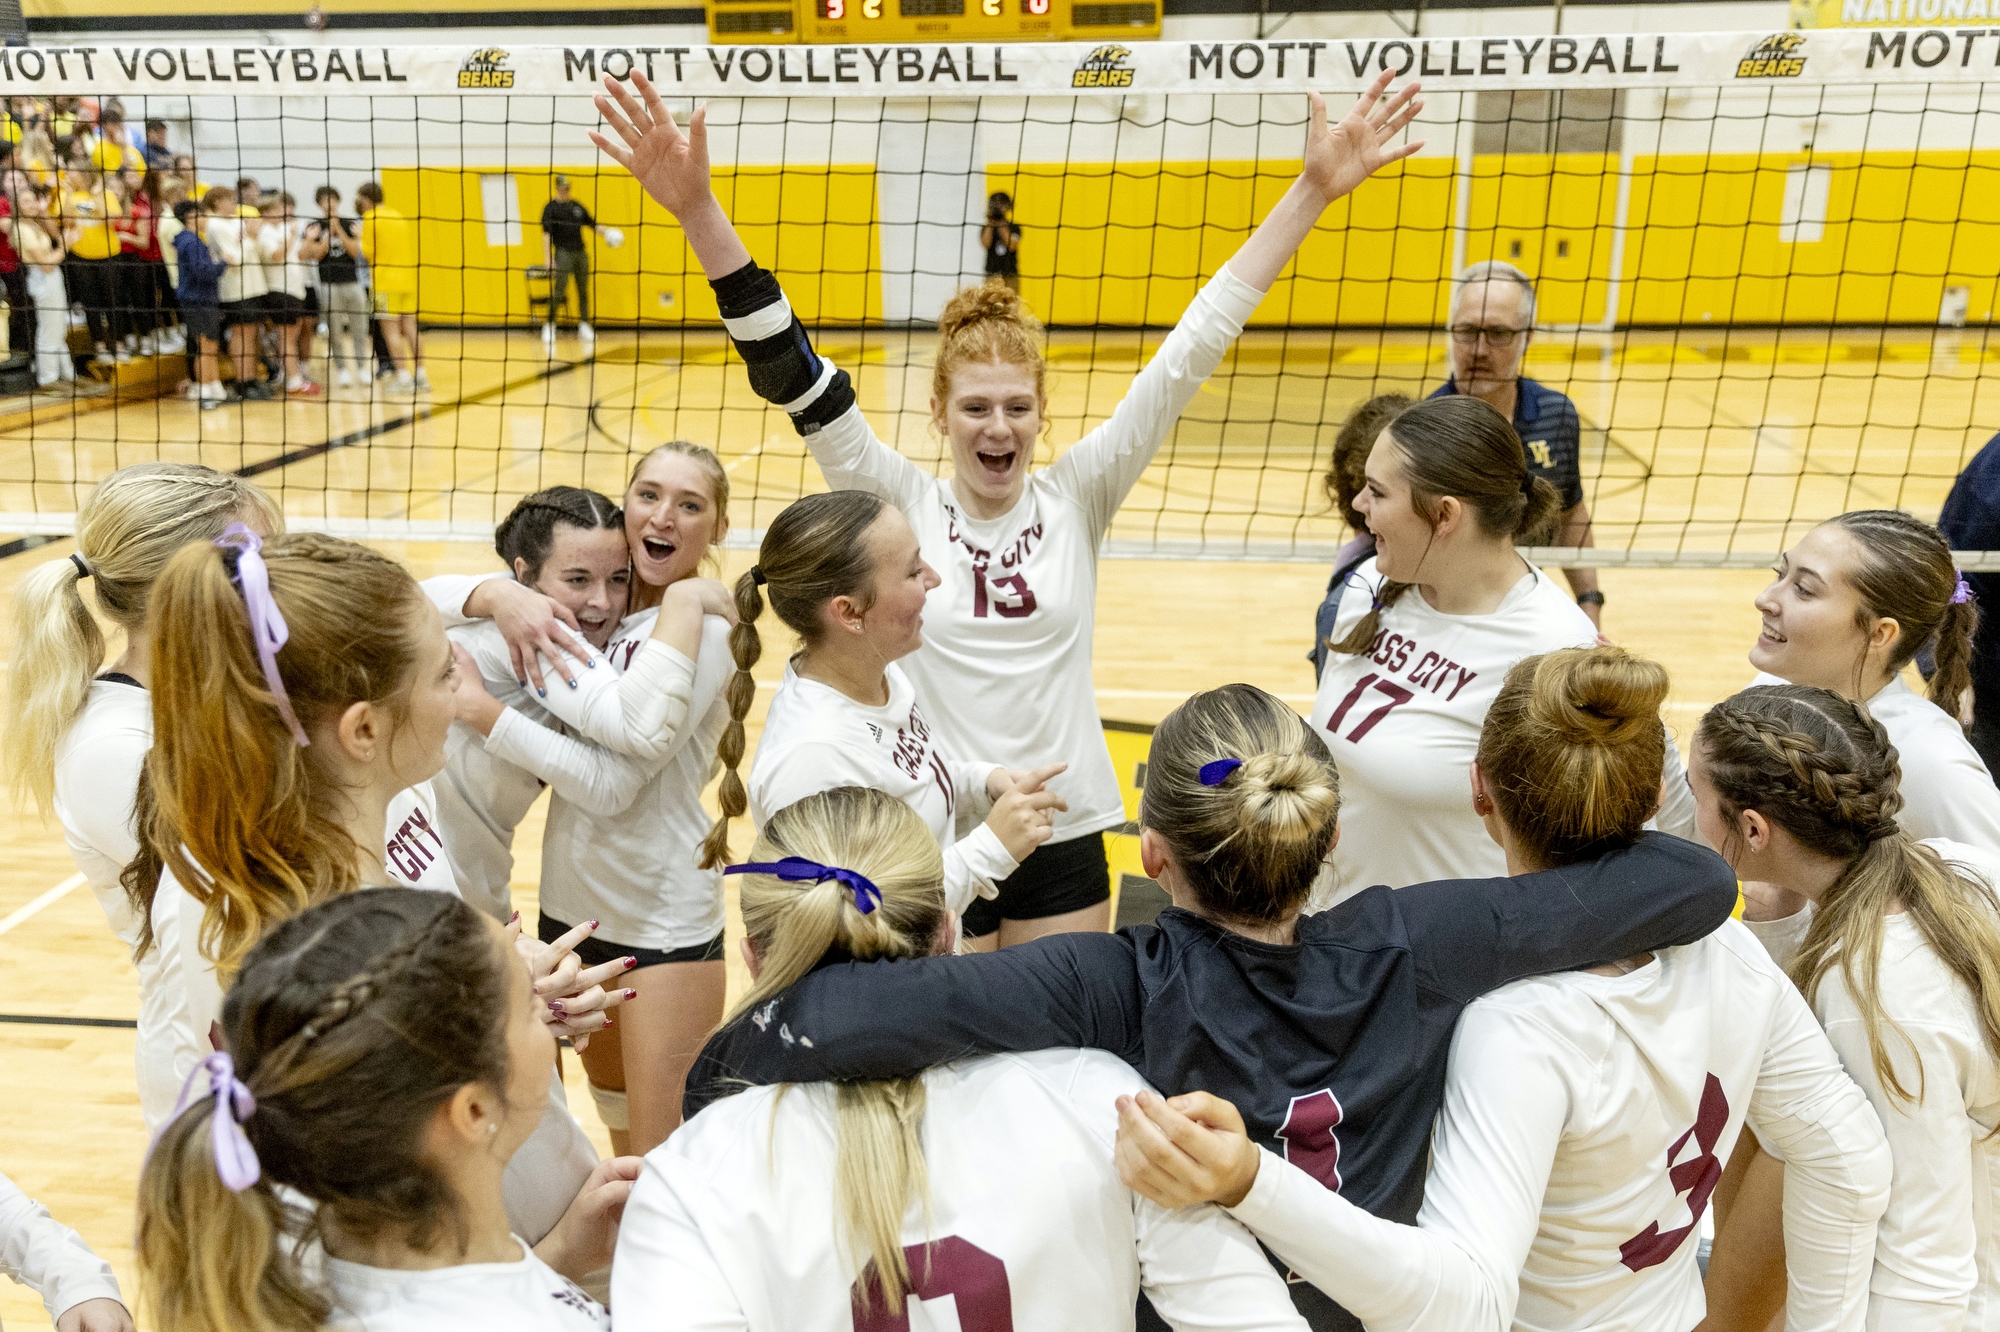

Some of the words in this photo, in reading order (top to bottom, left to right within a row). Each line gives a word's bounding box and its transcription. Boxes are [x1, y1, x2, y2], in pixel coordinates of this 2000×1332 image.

[113, 47, 407, 82] VOLLEYBALL
[459, 70, 514, 88] BEARS
[564, 47, 690, 82] MOTT
[707, 46, 1018, 82] VOLLEYBALL
[1073, 69, 1135, 87] BEARS
[1190, 42, 1326, 79] MOTT
[1346, 36, 1679, 77] VOLLEYBALL
[1736, 58, 1806, 77] BEARS
[973, 564, 1037, 618] 13
[1361, 628, 1416, 673] ASS
[1407, 651, 1478, 701] CITY
[1326, 673, 1415, 744] 17
[893, 728, 925, 780] CASS
[387, 807, 443, 882] CITY
